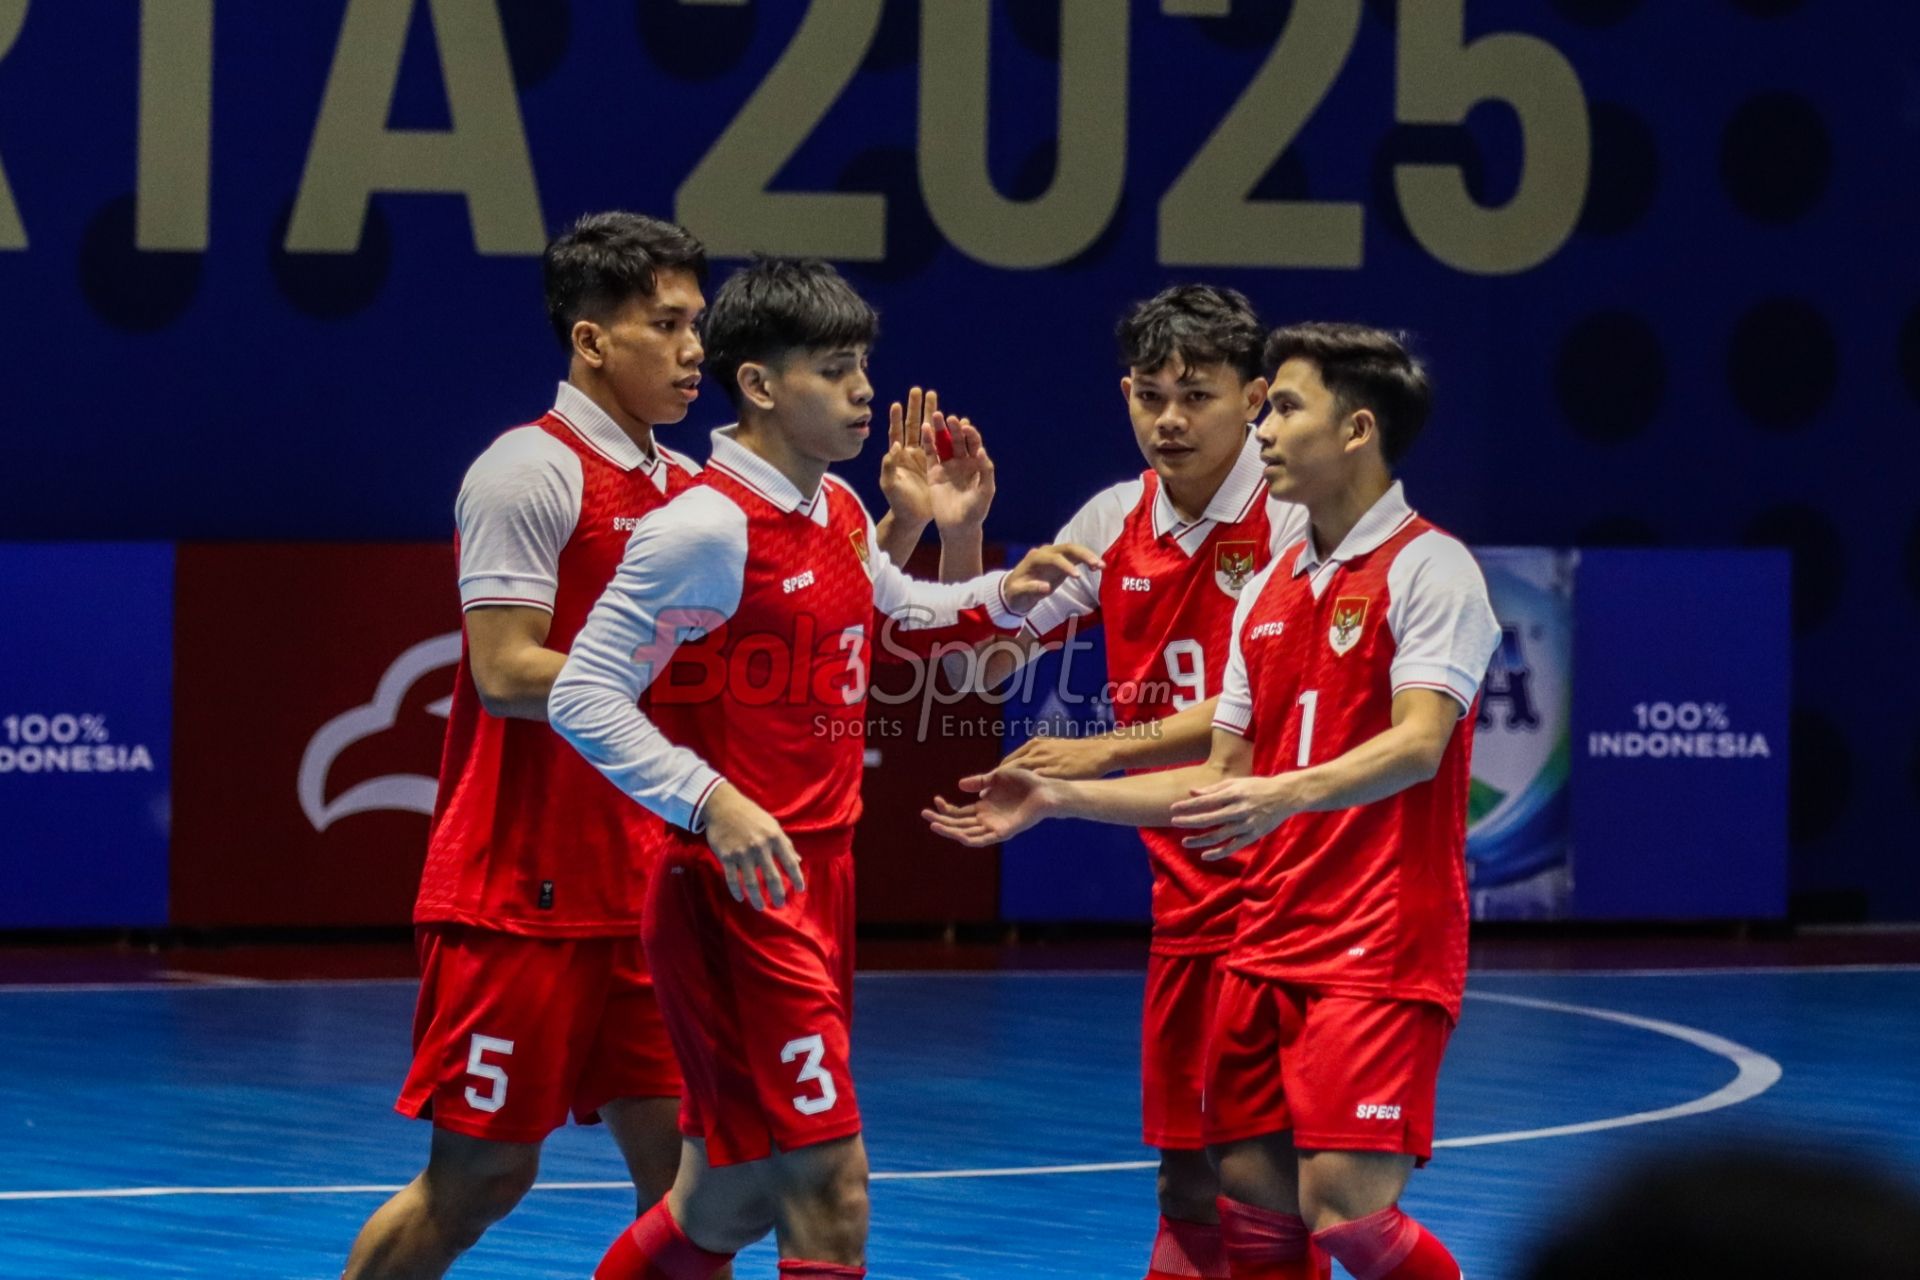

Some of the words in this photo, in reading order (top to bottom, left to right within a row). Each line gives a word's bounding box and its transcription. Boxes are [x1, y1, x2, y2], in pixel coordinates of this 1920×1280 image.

[0, 0, 547, 256] TA
[675, 0, 1592, 275] 2025
[782, 570, 815, 594] SPECS
[1121, 576, 1151, 592] PECS
[1250, 621, 1284, 640] SPECS
[839, 624, 865, 705] 3
[1163, 638, 1206, 713] 9
[3, 713, 109, 744] 100%
[1296, 690, 1319, 767] 1
[1633, 702, 1730, 730] 100%
[1588, 732, 1771, 758] INDONESIA
[464, 1033, 515, 1113] 5
[780, 1033, 837, 1116] 3
[1356, 1104, 1401, 1120] SPECS
